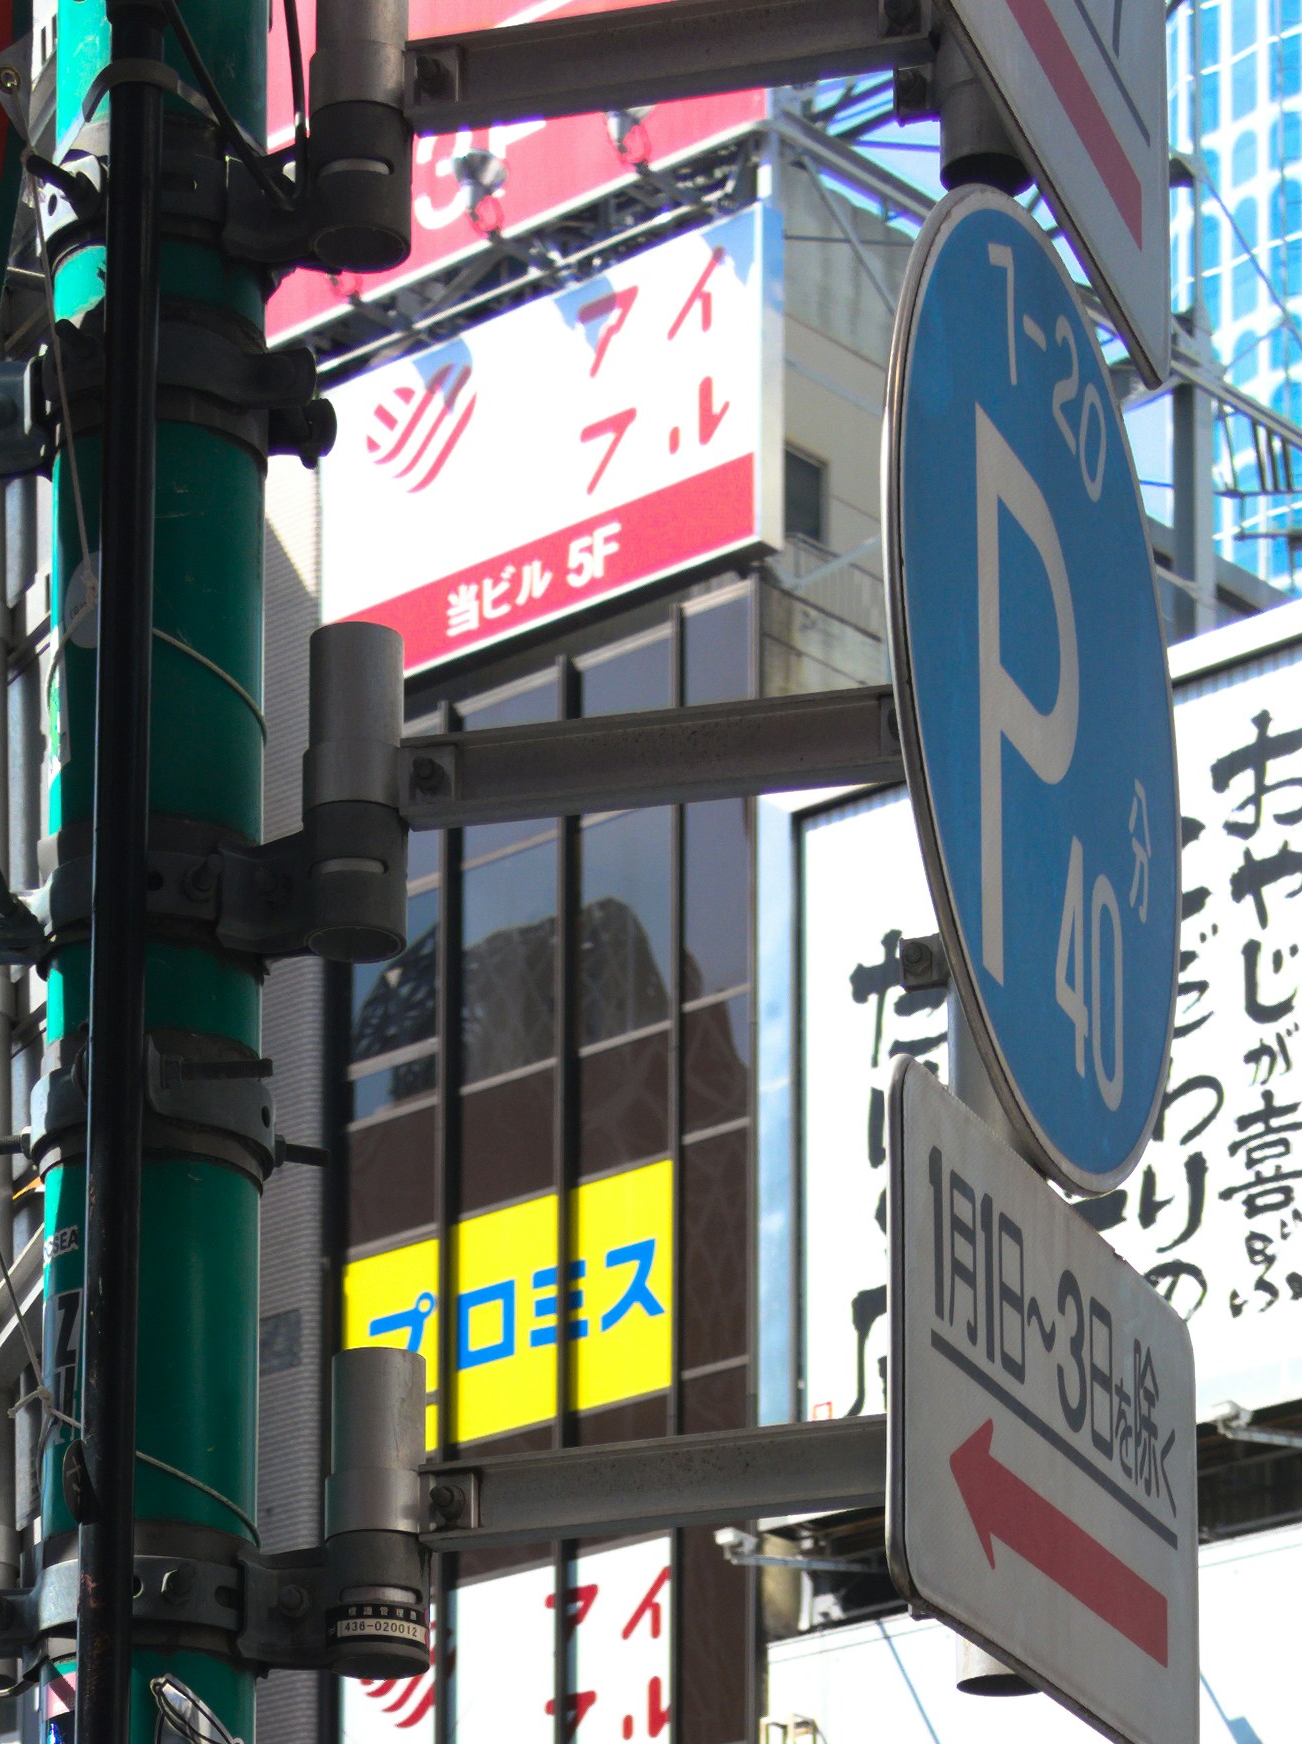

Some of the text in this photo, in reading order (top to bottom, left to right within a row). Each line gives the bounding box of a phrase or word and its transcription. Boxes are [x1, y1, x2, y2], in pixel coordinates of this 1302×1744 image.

[444, 521, 622, 638] 当ビル 5F
[974, 402, 1080, 988] P
[369, 1237, 666, 1370] プロミス
